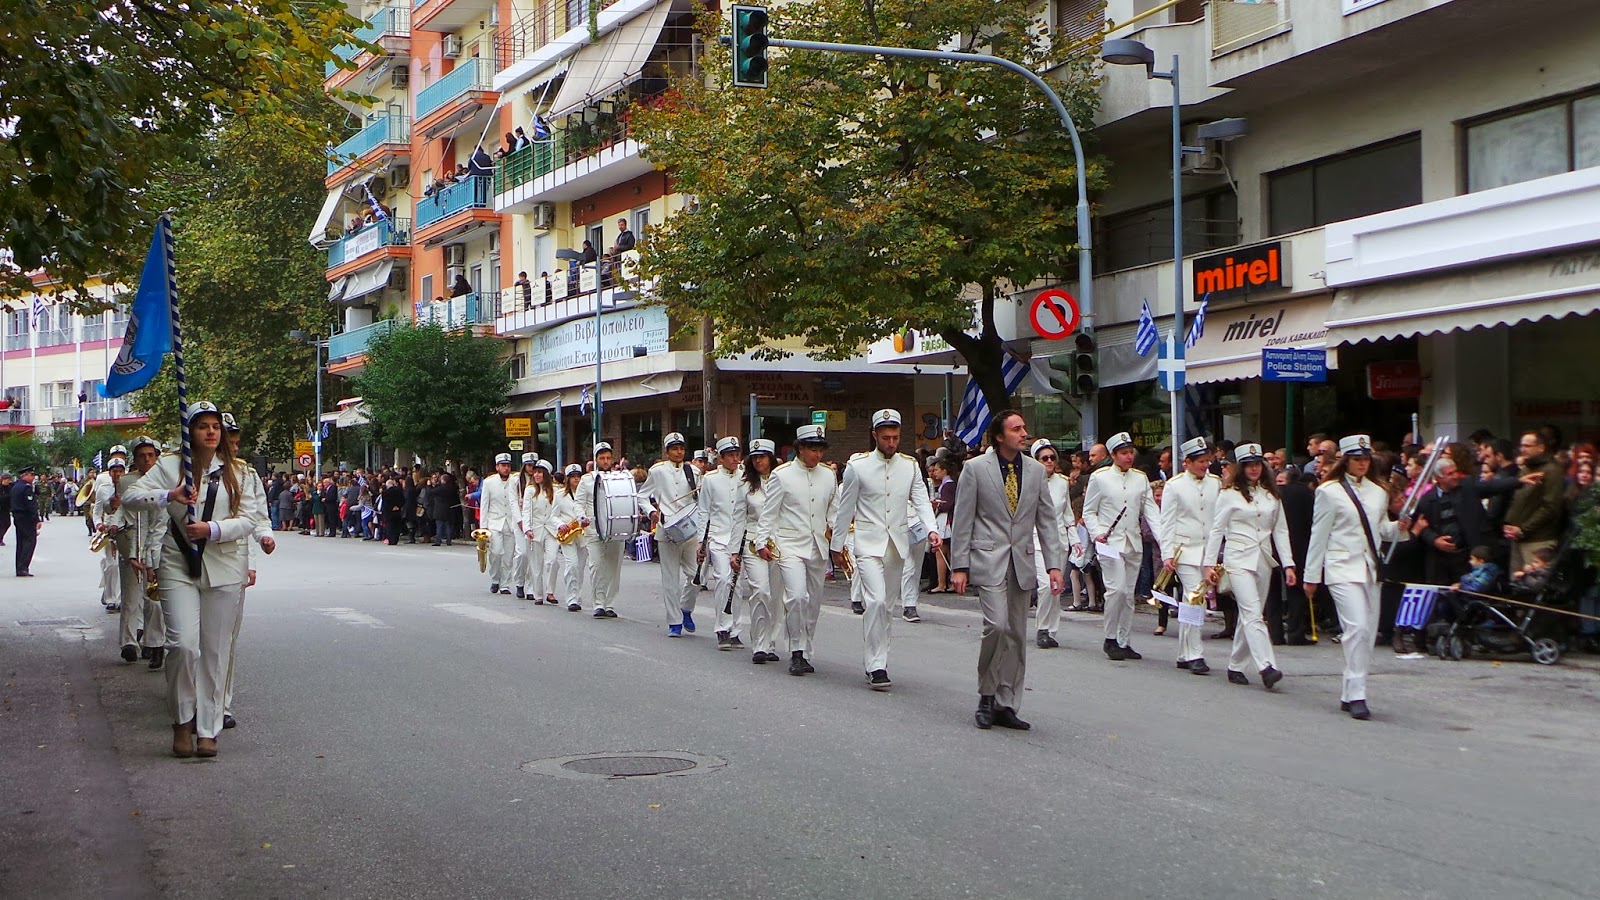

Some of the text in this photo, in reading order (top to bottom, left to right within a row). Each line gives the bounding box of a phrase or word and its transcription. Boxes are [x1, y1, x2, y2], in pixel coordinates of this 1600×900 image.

[1196, 249, 1279, 294] mirel
[575, 313, 645, 344] Βιβλοπωλείο
[1222, 309, 1285, 343] mirel
[575, 341, 643, 364] Επικιρότη
[1265, 336, 1287, 347] ΣΟΦΙΑ
[1267, 361, 1323, 371] Police Station
[751, 382, 803, 391] ΣΧΟΛΙΚΑ
